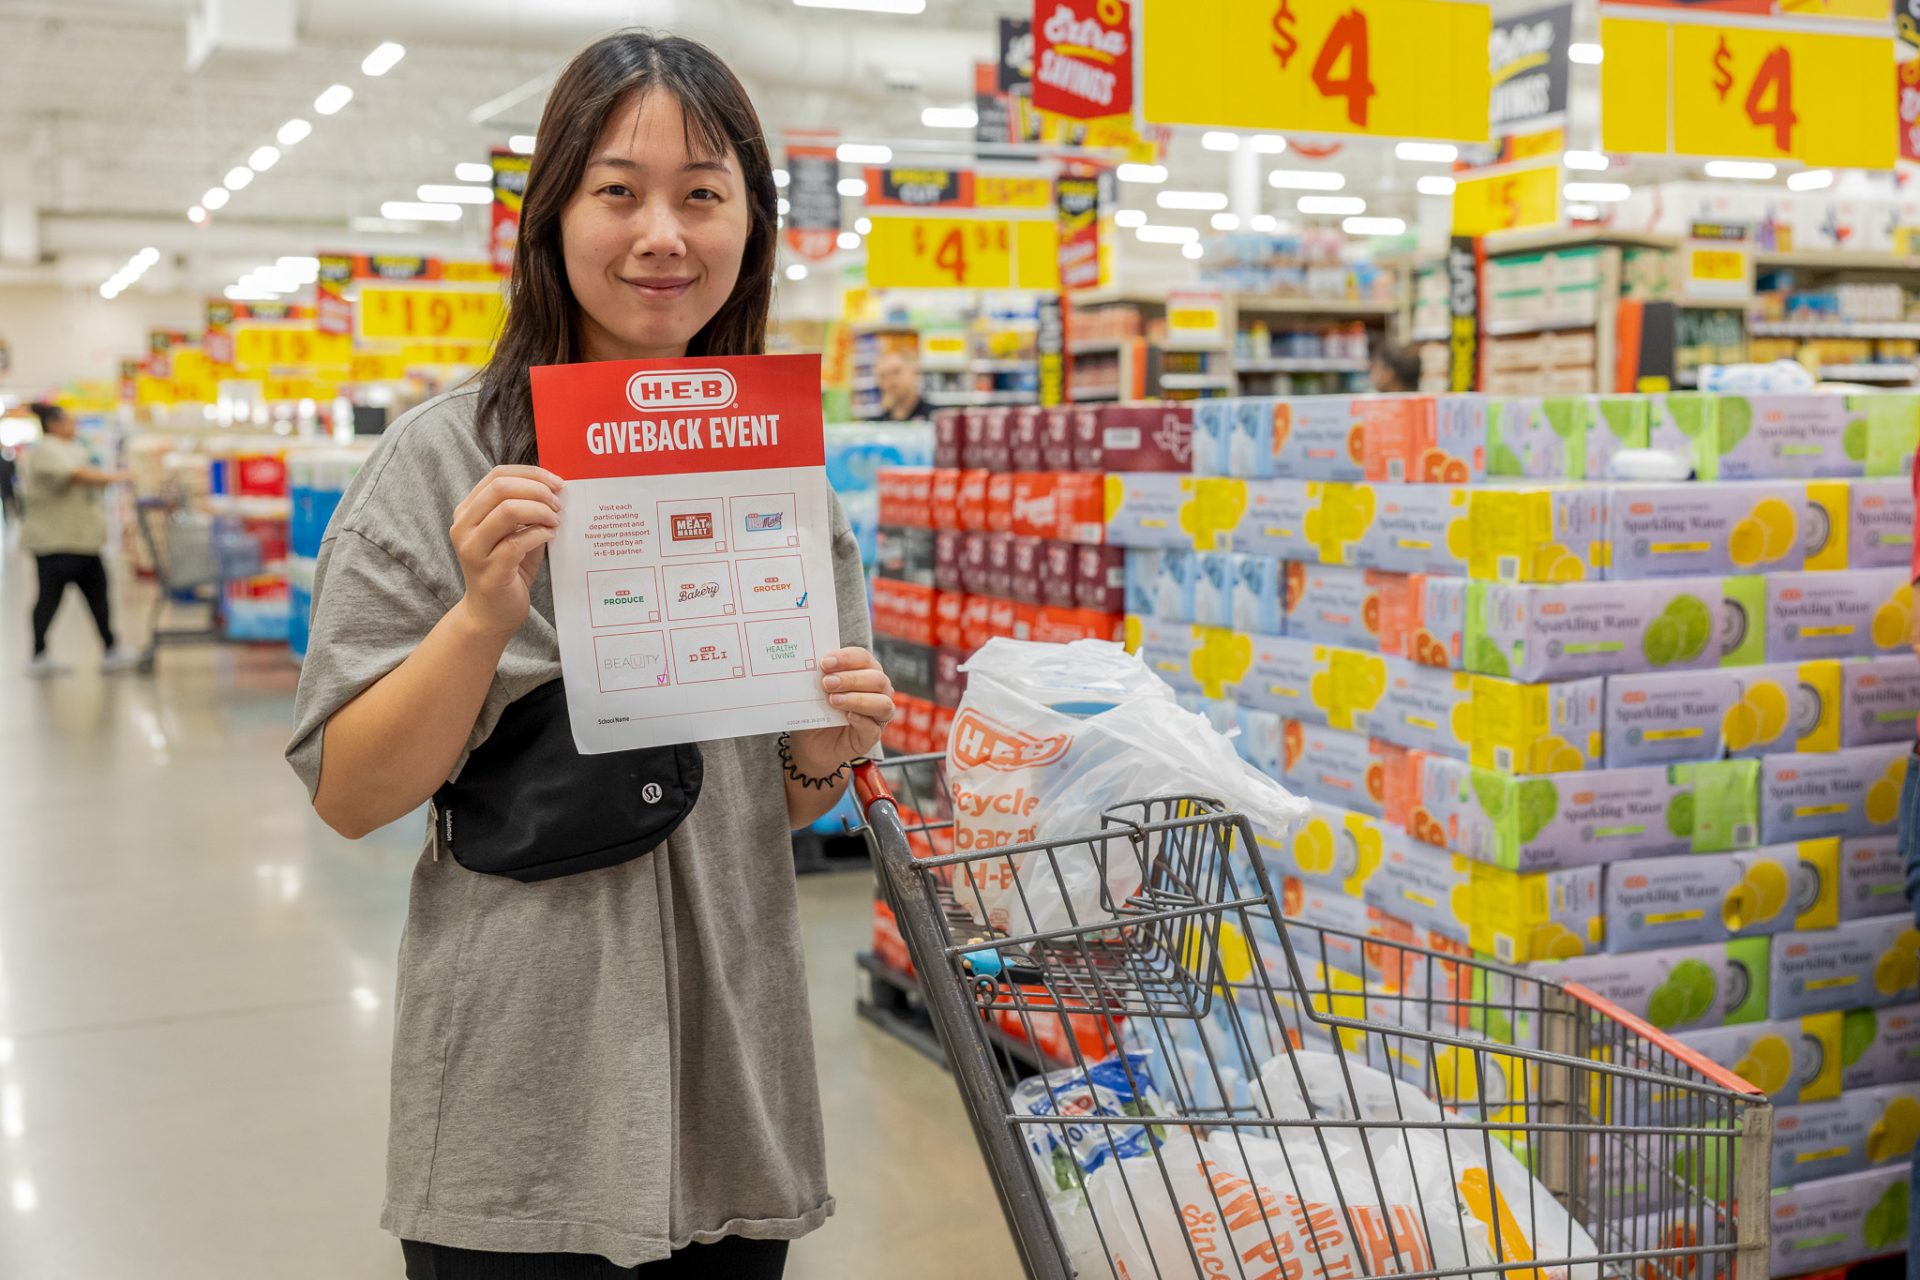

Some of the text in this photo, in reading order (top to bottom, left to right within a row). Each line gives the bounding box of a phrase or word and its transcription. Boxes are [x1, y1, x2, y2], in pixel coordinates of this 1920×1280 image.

[641, 379, 723, 401] H-E-B
[586, 414, 780, 456] GIVEBACK EVENT
[615, 503, 632, 511] each
[593, 512, 639, 521] participating
[588, 521, 630, 530] department
[676, 519, 707, 530] MEAT
[619, 529, 650, 538] passport
[677, 528, 708, 537] MARKET
[593, 540, 624, 548] stamped
[624, 539, 633, 547] by
[678, 582, 719, 602] Bakery
[753, 583, 791, 593] GROCERY
[604, 596, 645, 605] PRODUCE
[766, 643, 798, 653] HEALTHY
[689, 651, 727, 662] DELI
[771, 651, 796, 660] LIVING
[604, 653, 660, 670] BEAUTY
[598, 717, 614, 725] School
